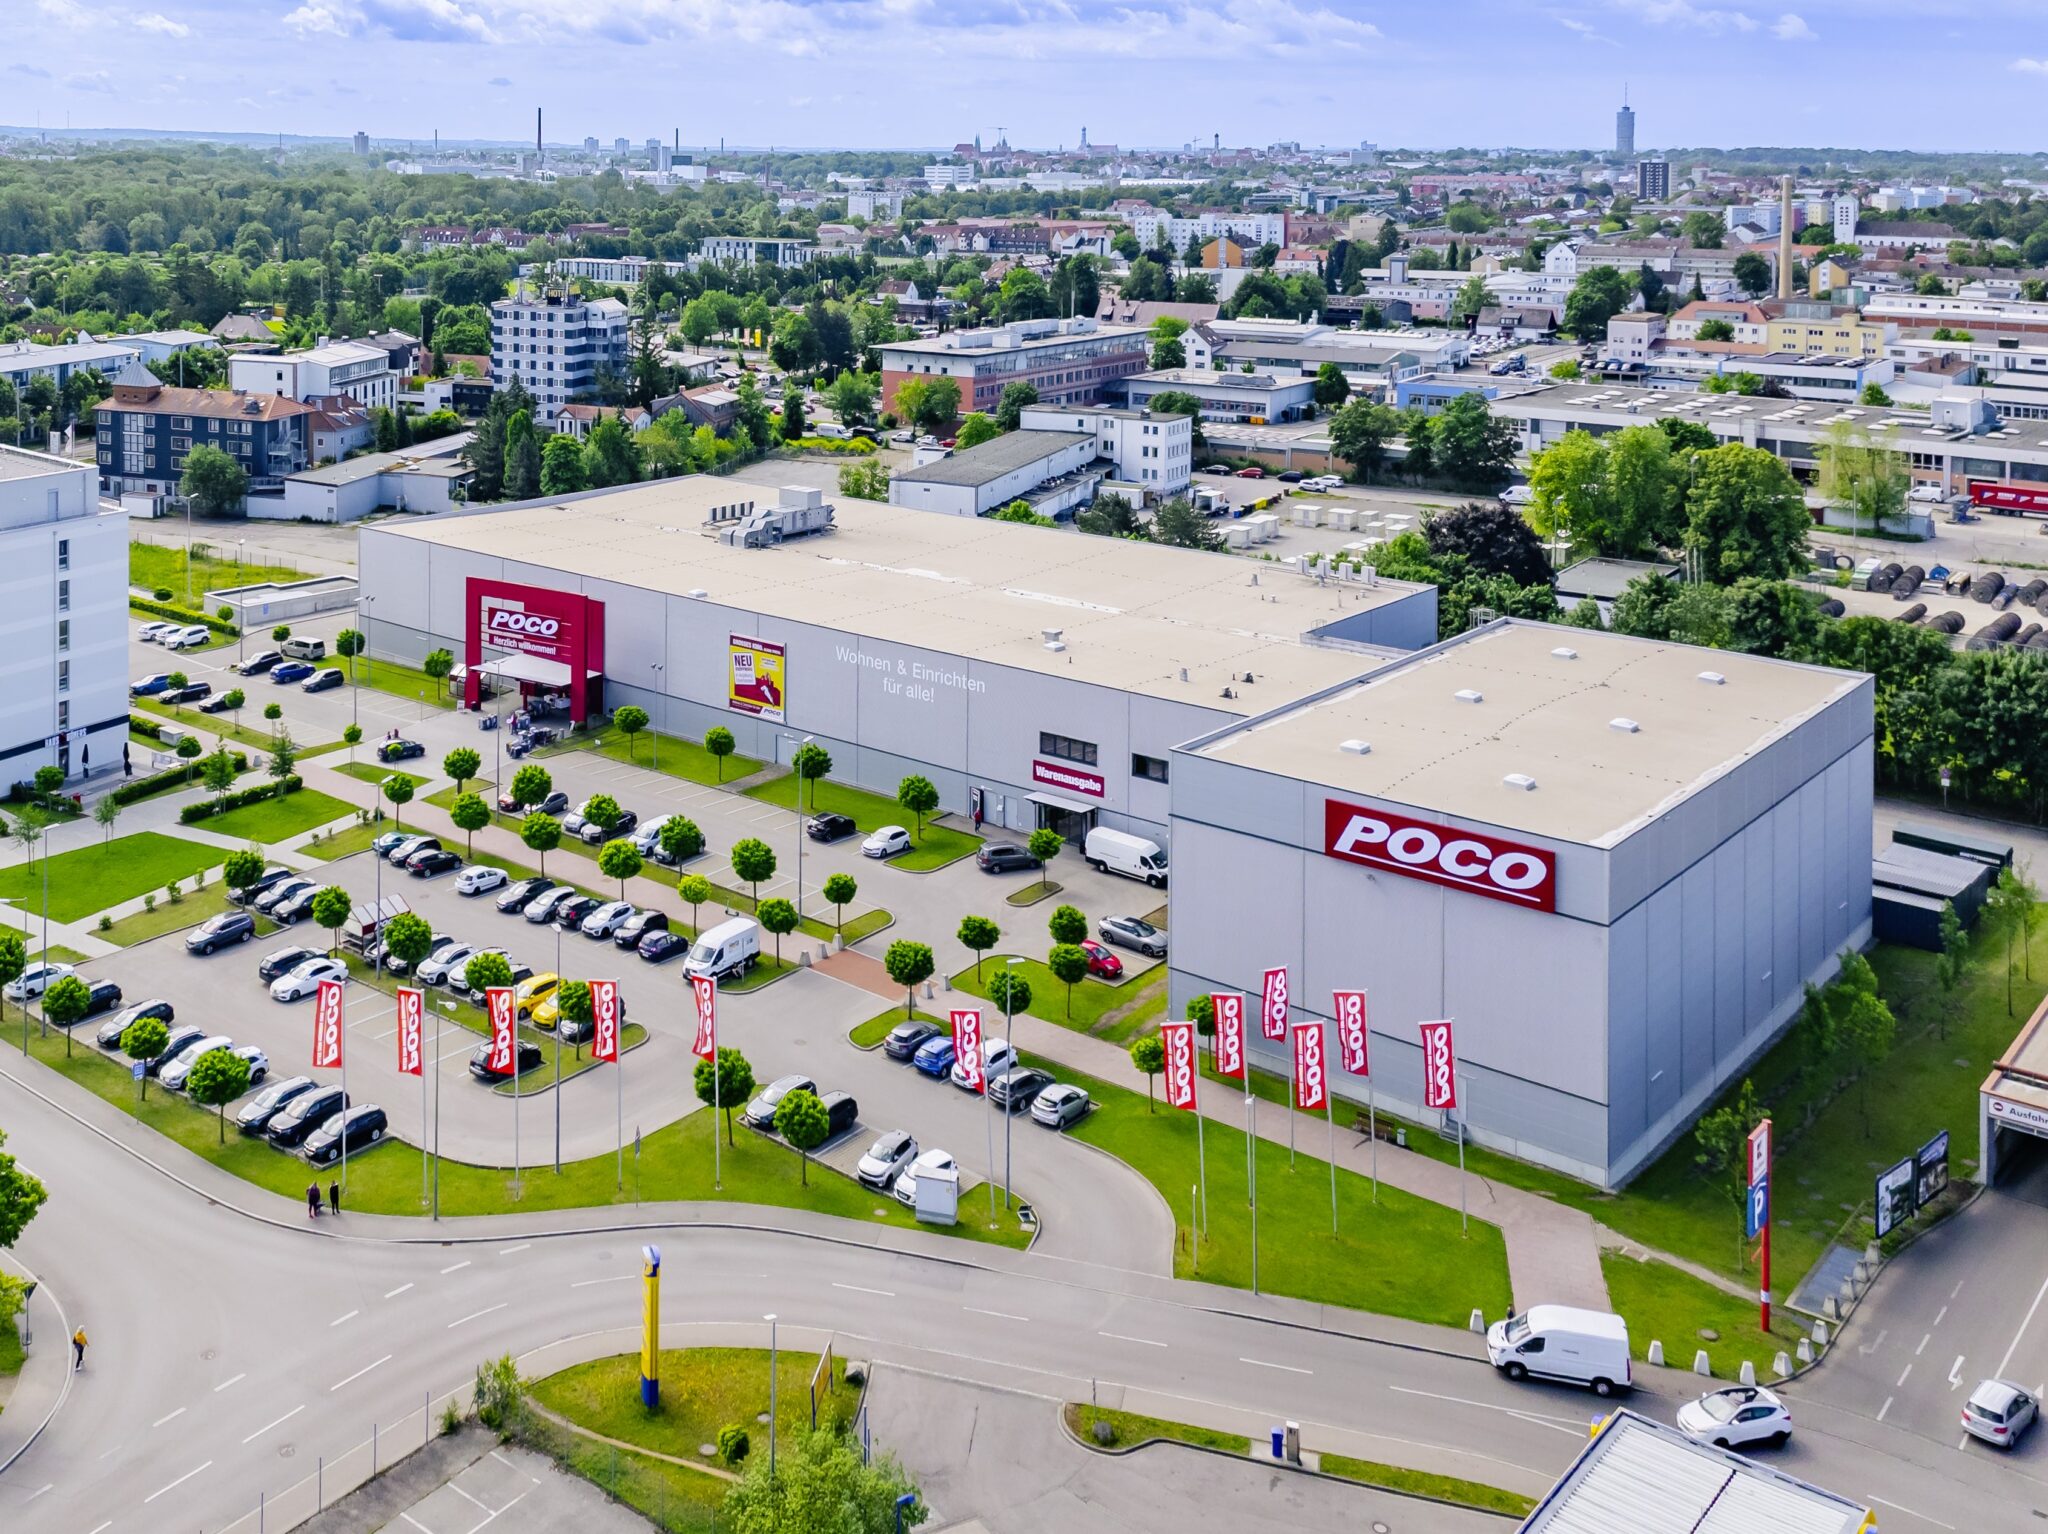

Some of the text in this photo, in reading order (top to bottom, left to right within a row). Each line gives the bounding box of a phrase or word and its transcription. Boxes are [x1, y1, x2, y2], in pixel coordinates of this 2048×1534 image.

[490, 610, 559, 635] POCO
[493, 635, 557, 656] Herzlich willkommen!
[734, 654, 753, 667] NEU
[835, 645, 986, 694] Wohnen & Einrichten
[882, 677, 935, 703] für alle!
[1035, 765, 1102, 793] Warenausgabe
[1332, 814, 1547, 890] POCO
